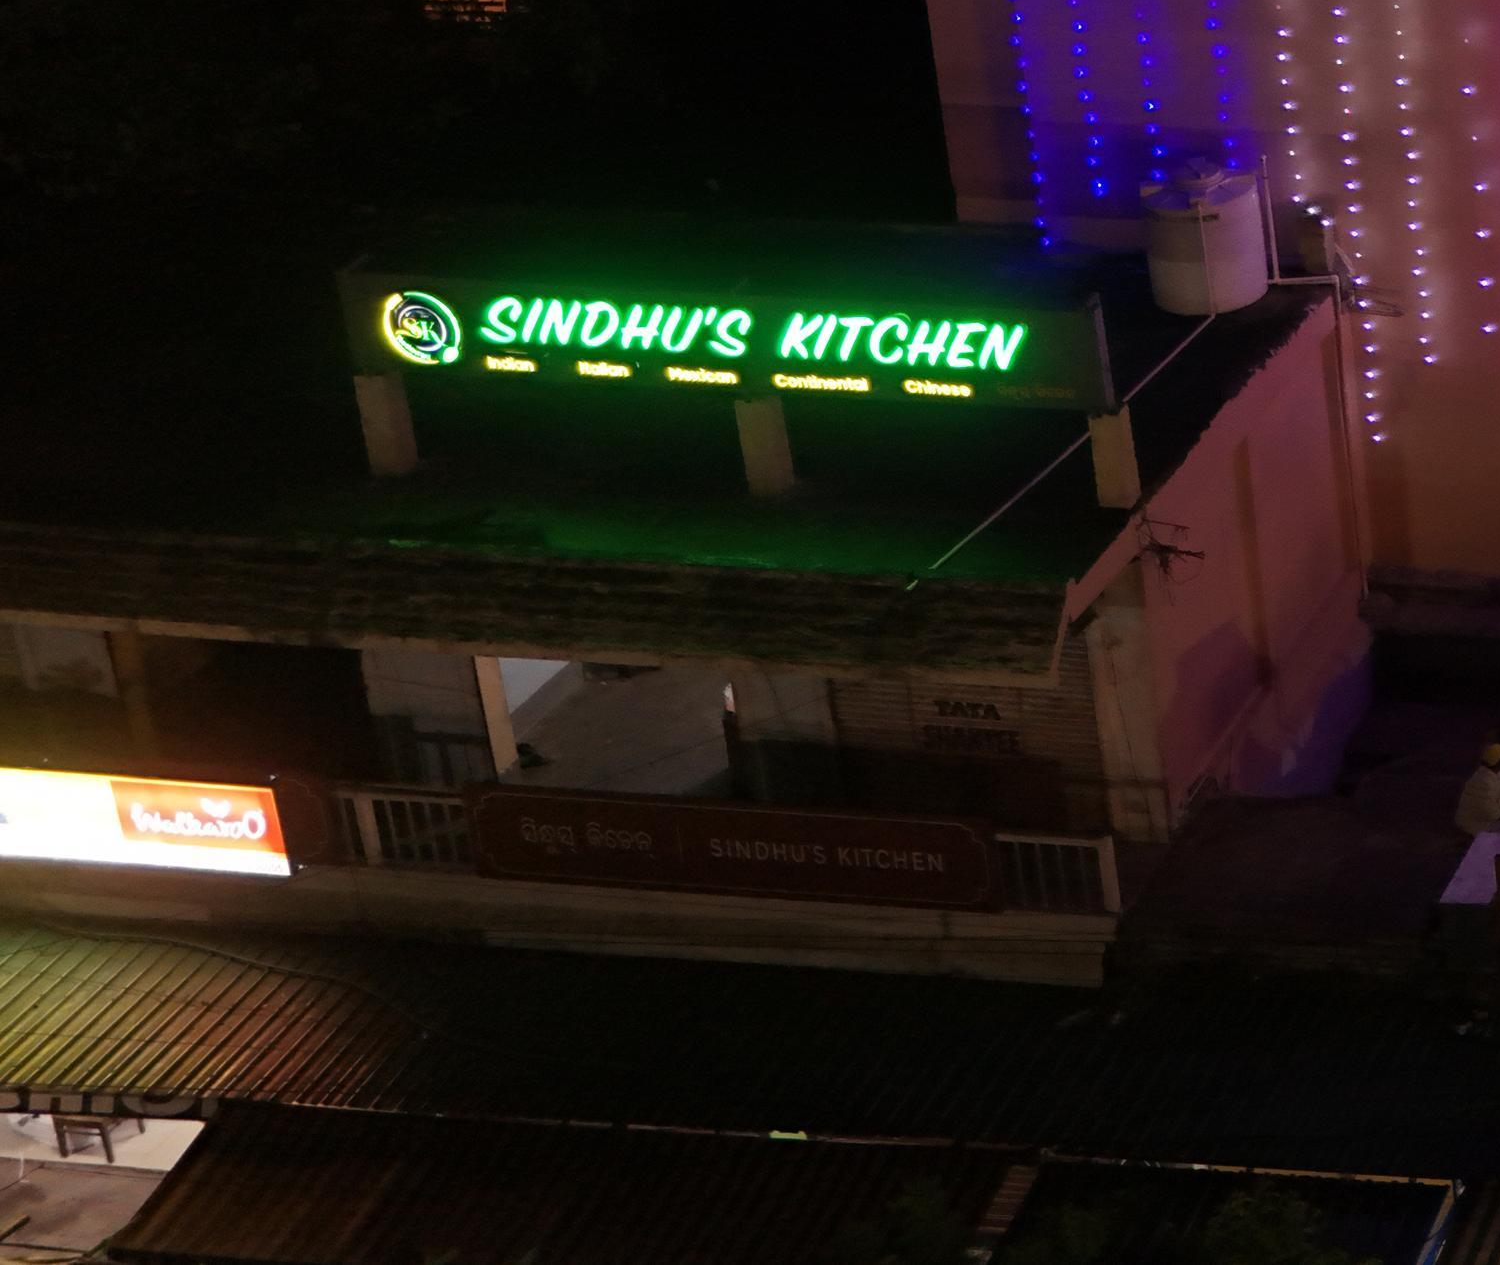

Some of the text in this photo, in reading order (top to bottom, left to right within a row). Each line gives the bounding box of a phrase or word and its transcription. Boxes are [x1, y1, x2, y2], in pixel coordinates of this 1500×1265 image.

[481, 295, 755, 360] SINDHU'S
[780, 312, 1029, 371] KITCHEN
[485, 355, 973, 399] Indian Italian Mexican Continental Chinese
[709, 837, 946, 872] SINDHU'S KITCHEN
